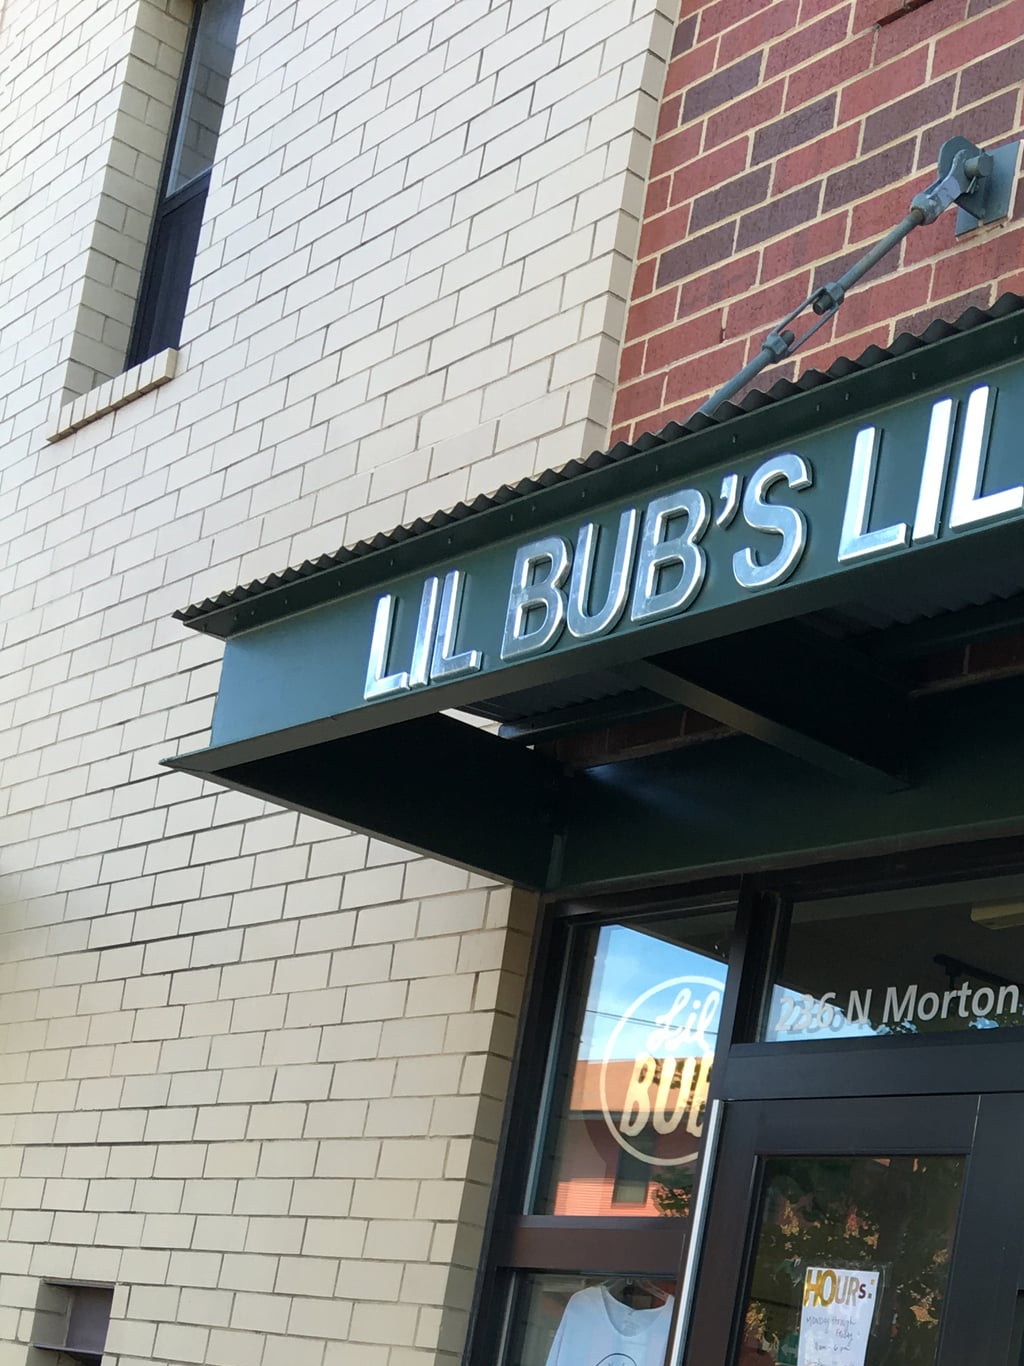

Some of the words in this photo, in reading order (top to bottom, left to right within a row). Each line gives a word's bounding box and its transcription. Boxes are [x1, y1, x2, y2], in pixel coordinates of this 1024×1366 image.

[364, 570, 482, 700] LIL
[500, 452, 814, 662] BUB'S
[646, 987, 721, 1052] Lil
[776, 991, 836, 1031] 236
[847, 988, 872, 1025] N
[882, 981, 1019, 1023] Morton
